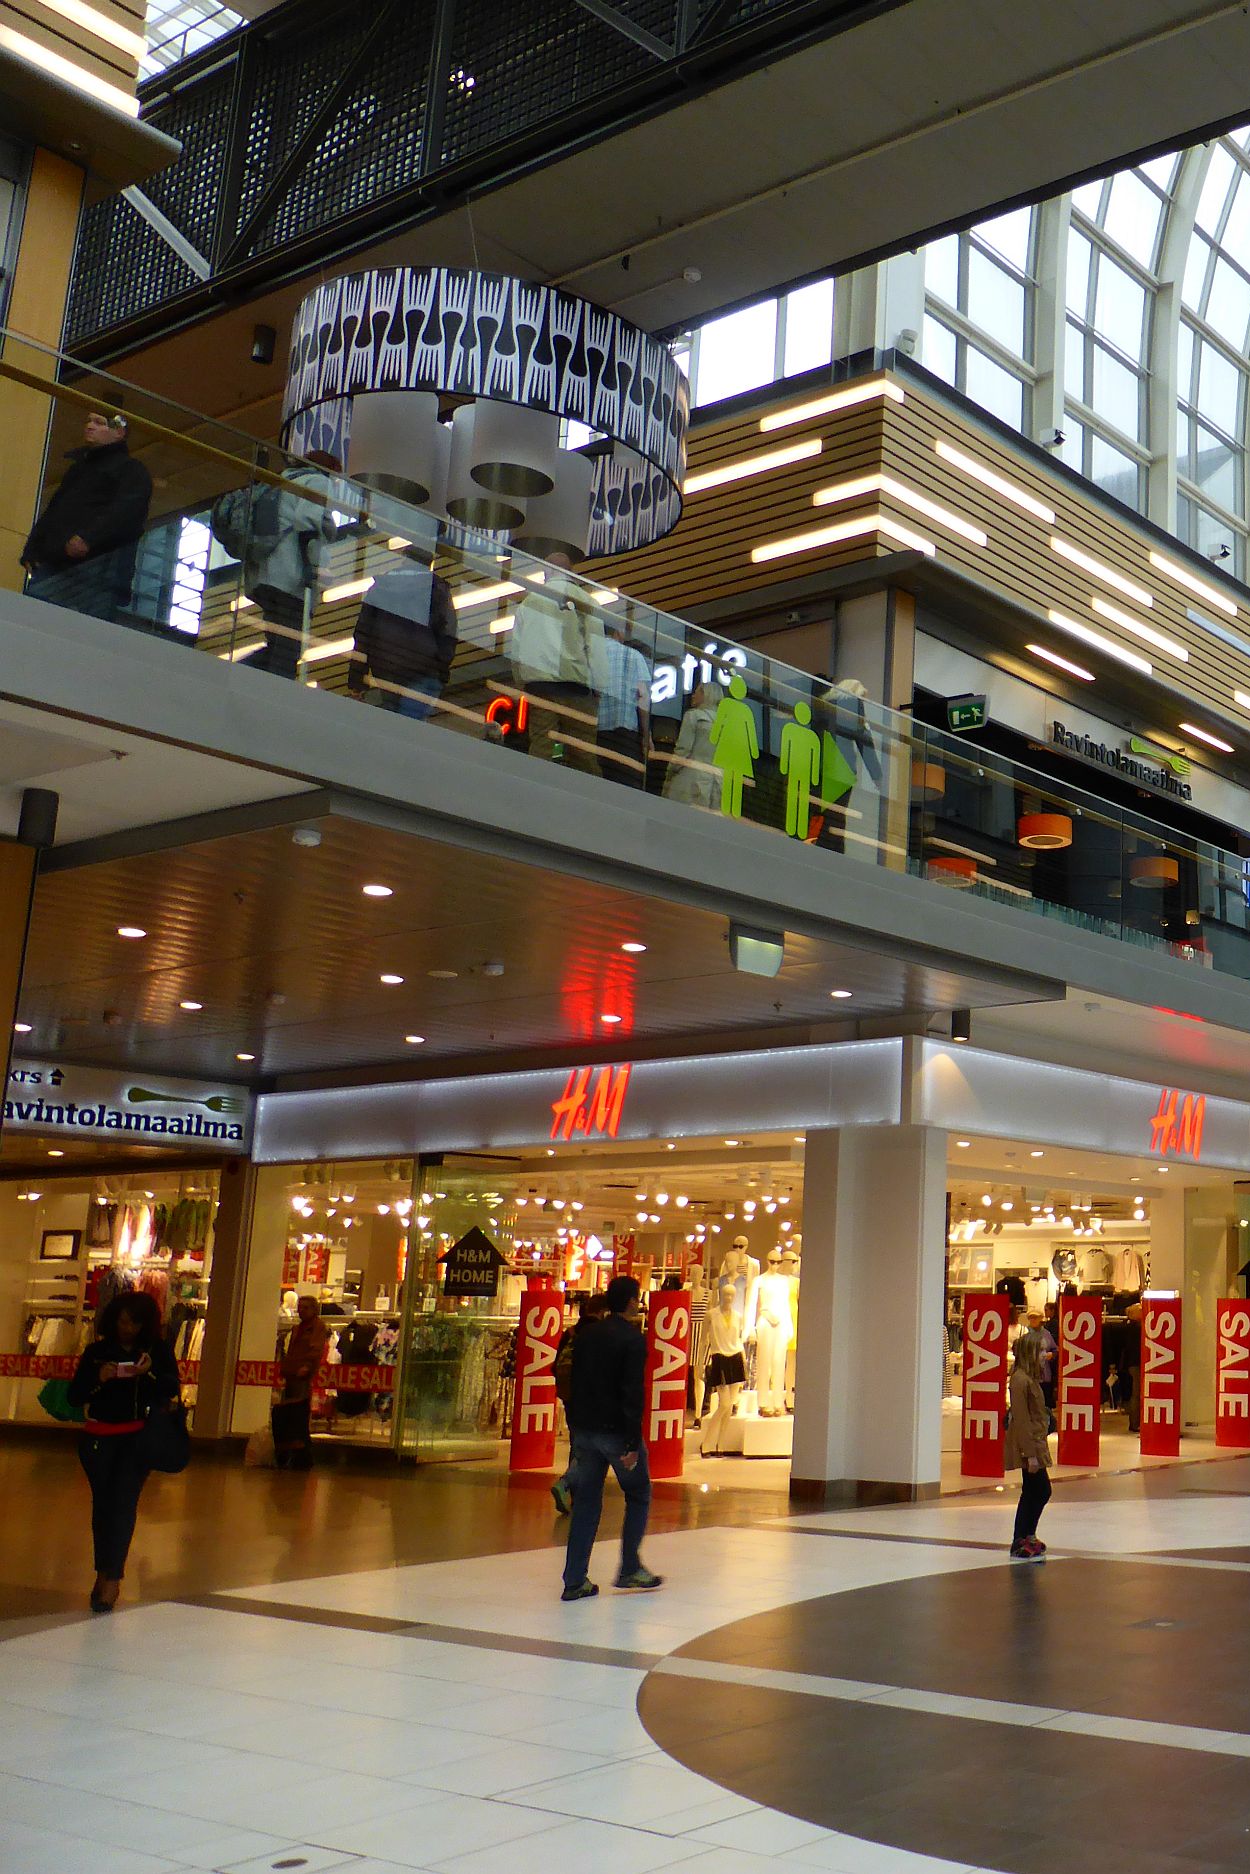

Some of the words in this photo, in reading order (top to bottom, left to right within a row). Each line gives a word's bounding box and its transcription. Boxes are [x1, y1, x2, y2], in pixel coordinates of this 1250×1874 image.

[1053, 721, 1192, 801] Ravintolamaailma
[2, 1098, 244, 1141] avintolamaailma
[550, 1062, 632, 1141] H&M
[1149, 1087, 1207, 1162] H&M
[450, 1270, 494, 1284] HOME
[456, 1249, 491, 1263] H&M
[238, 1361, 274, 1385] SALE
[317, 1365, 356, 1388] SALE
[519, 1305, 561, 1434] SALE
[649, 1306, 689, 1441] SALE
[965, 1309, 1003, 1441] SALE
[1061, 1310, 1096, 1432] SALE
[1144, 1311, 1176, 1425] SALE
[1218, 1311, 1250, 1418] SALE
